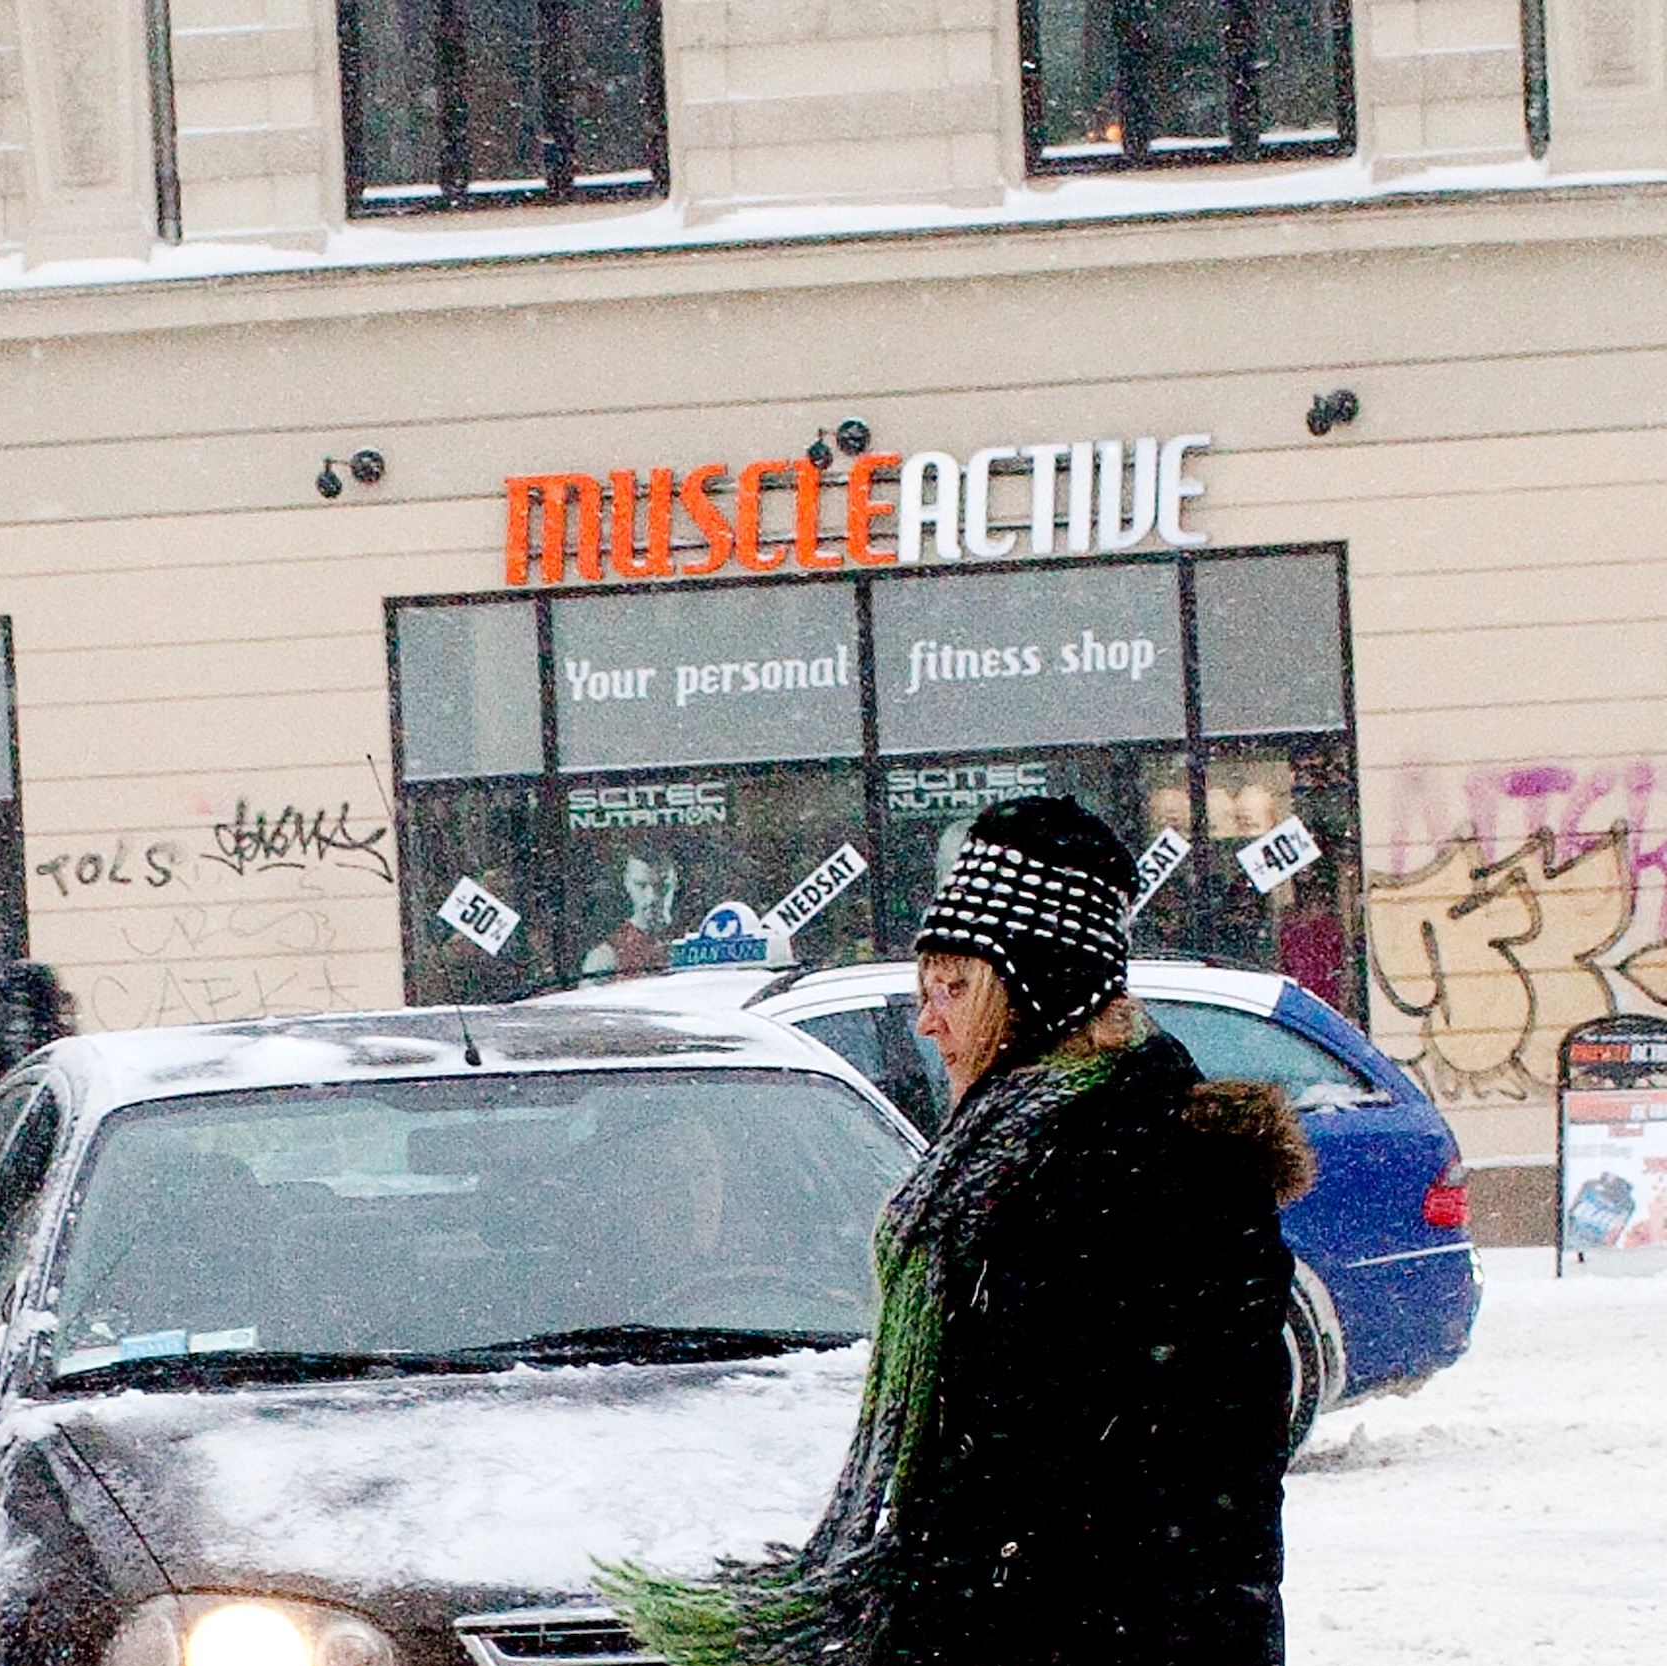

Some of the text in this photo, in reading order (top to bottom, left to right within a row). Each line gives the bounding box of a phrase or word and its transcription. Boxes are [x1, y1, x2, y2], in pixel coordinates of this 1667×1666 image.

[564, 628, 1155, 708] Your personal fitness shop
[885, 761, 1048, 793] SCITEC
[568, 780, 727, 811] SCITEC
[569, 804, 728, 830] NUTRITION
[775, 852, 856, 930] NEDSAT
